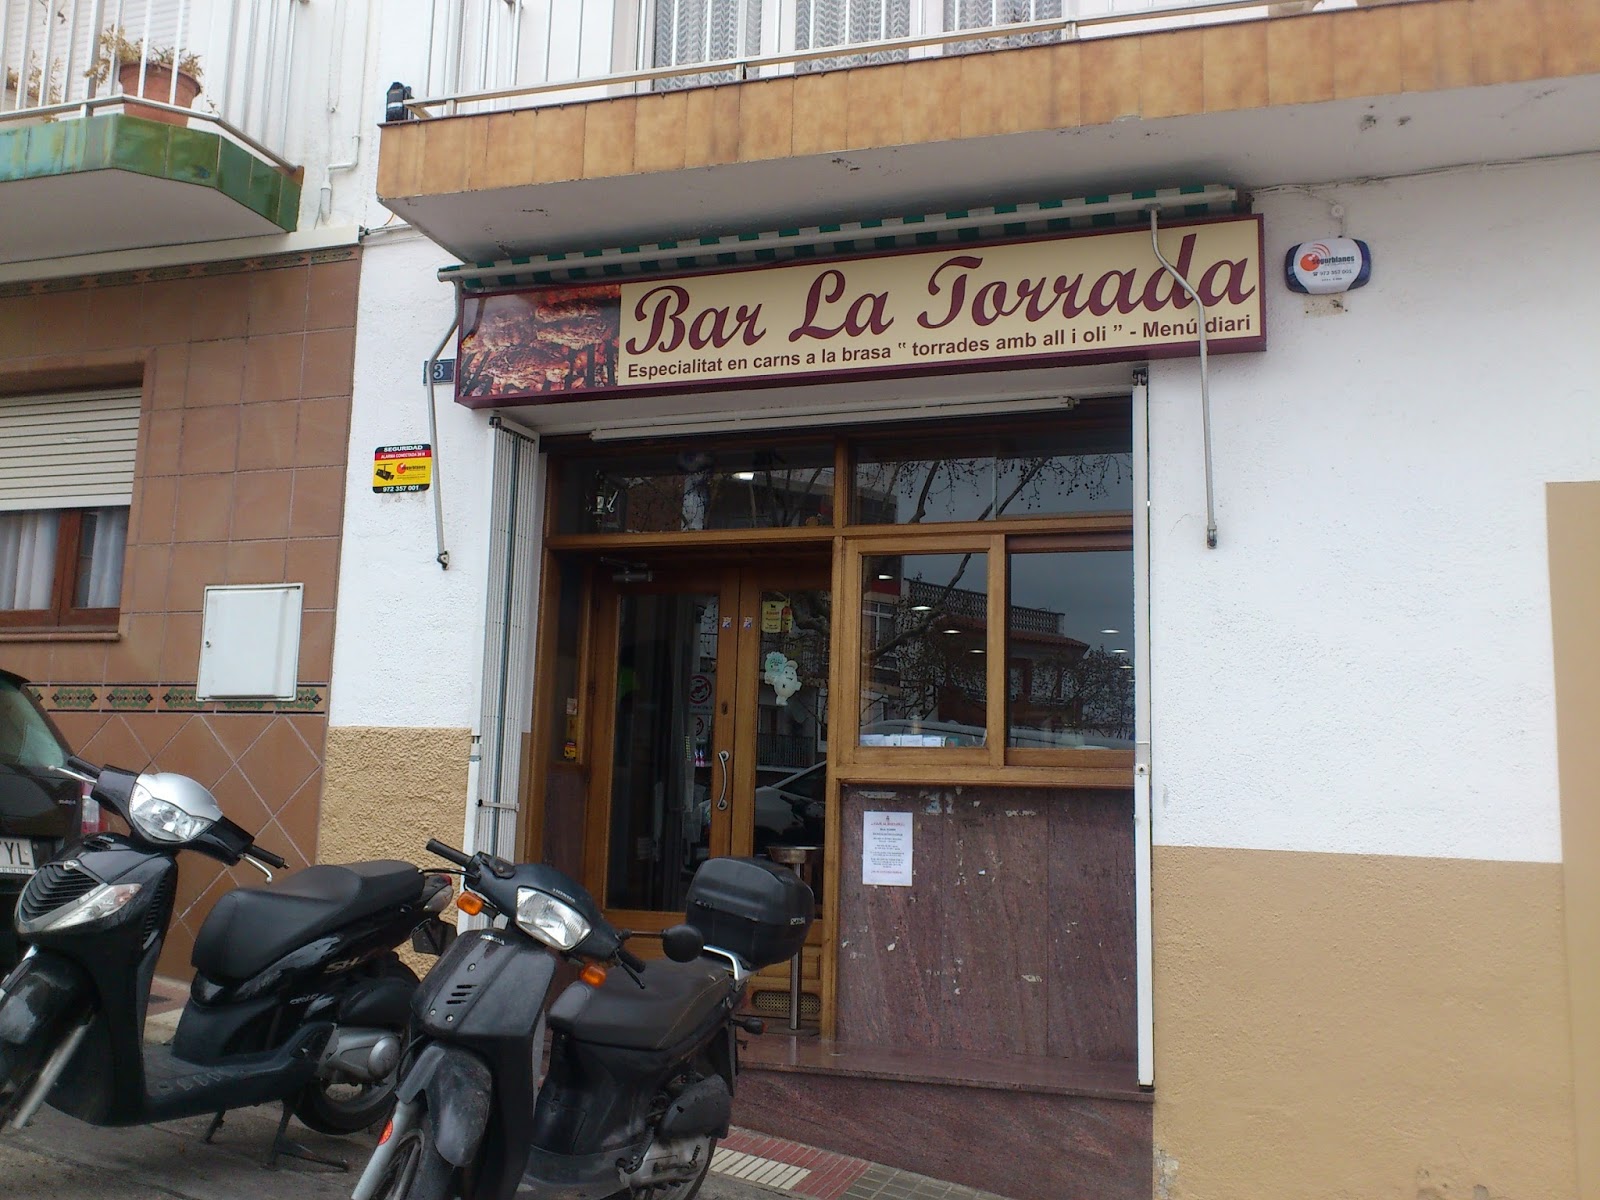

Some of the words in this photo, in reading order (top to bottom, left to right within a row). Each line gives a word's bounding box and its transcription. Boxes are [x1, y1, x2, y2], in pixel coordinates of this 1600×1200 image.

[625, 284, 767, 356] Bar
[788, 268, 895, 342] La
[916, 232, 1256, 330] Torrada
[628, 357, 723, 380] Especialitat
[727, 358, 748, 371] en
[753, 354, 801, 369] carns
[805, 352, 816, 365] a
[821, 348, 836, 364] la
[842, 346, 891, 362] brasa
[911, 337, 990, 357] torrades
[995, 332, 1037, 350] amb
[1042, 329, 1065, 347] all
[1071, 328, 1076, 344] i
[1082, 326, 1106, 343] oli
[1143, 317, 1199, 338] Menú
[1204, 314, 1250, 334] diari
[433, 363, 444, 379] 3
[0, 841, 30, 866] YL
